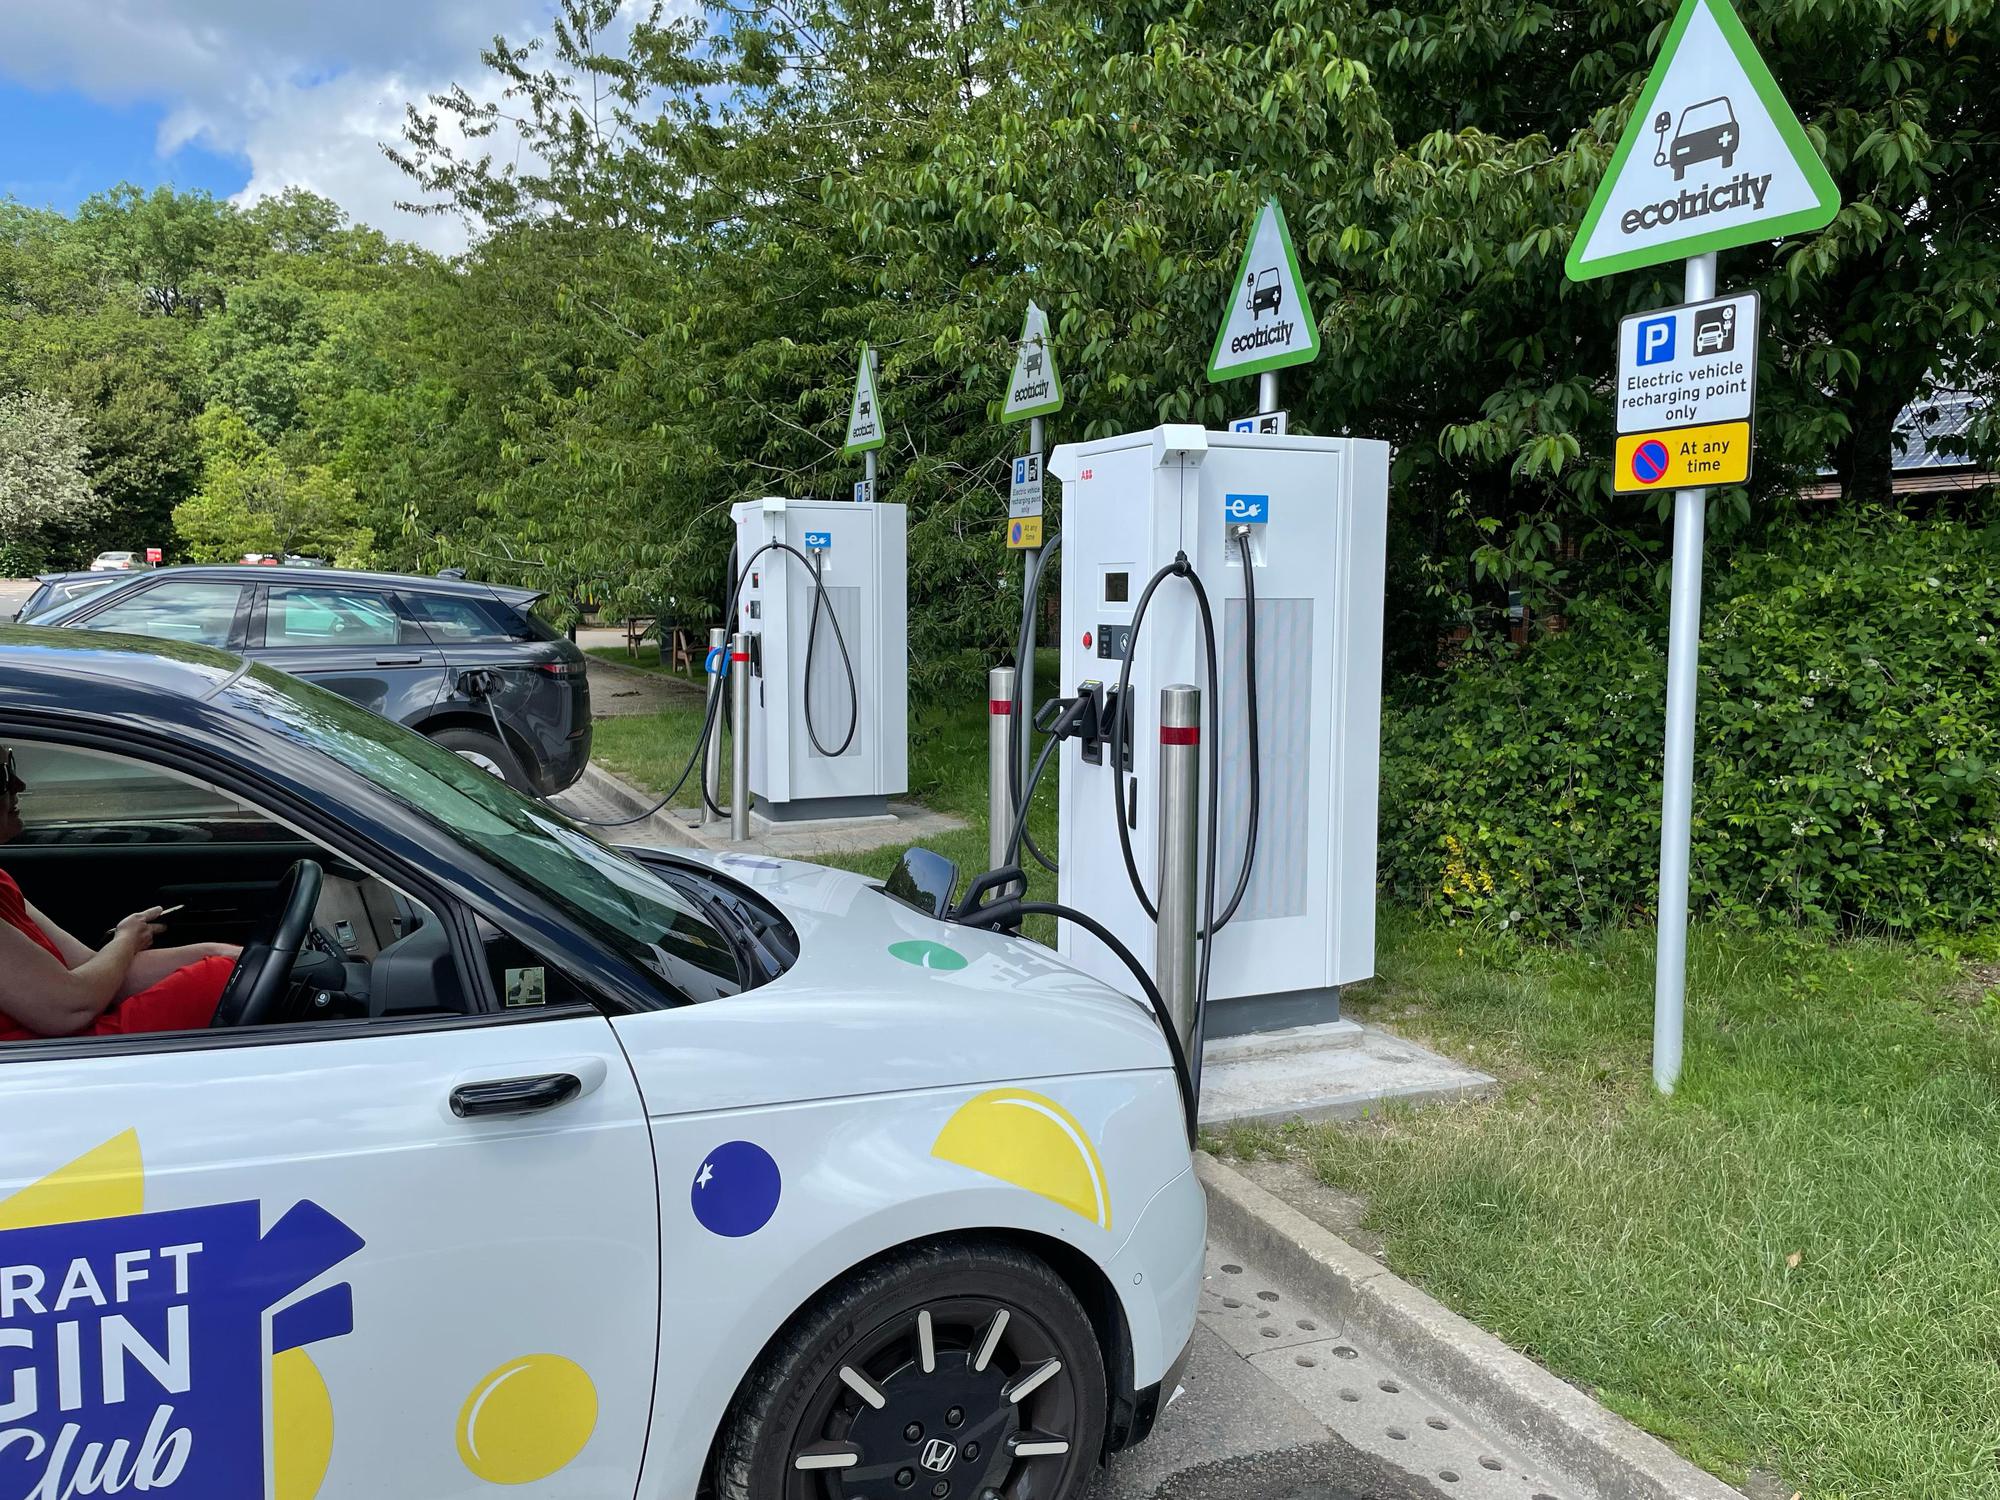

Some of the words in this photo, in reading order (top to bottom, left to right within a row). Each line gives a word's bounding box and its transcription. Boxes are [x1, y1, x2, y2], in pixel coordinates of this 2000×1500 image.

[1621, 173, 1772, 234] ecotricity
[1231, 320, 1294, 354] ecotricity
[1645, 323, 1669, 362] P
[1627, 369, 1684, 391] Electric
[1689, 361, 1743, 384] vehicle
[1014, 381, 1049, 402] ecotricity
[1622, 387, 1701, 411] recharging
[1706, 378, 1747, 400] point
[1665, 404, 1697, 422] only
[1680, 442, 1698, 456] At
[1703, 440, 1730, 458] any
[1081, 469, 1093, 480] ABB
[1687, 457, 1721, 473] time
[0, 1242, 203, 1318] RAFT
